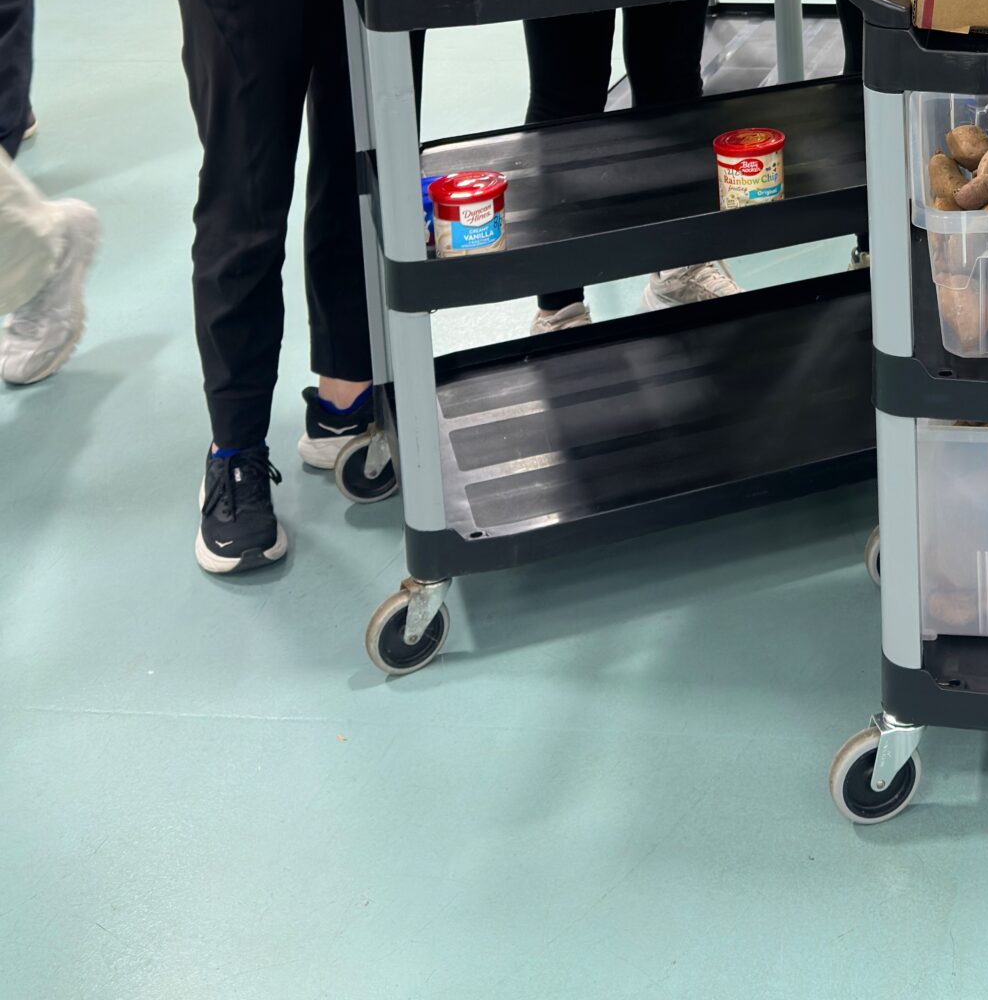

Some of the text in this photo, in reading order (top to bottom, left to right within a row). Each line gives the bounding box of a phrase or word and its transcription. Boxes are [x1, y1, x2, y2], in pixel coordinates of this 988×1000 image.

[723, 173, 778, 185] Rainbow Chip
[462, 204, 492, 218] Duncan
[467, 212, 491, 224] Hines
[463, 230, 494, 241] VANILLA
